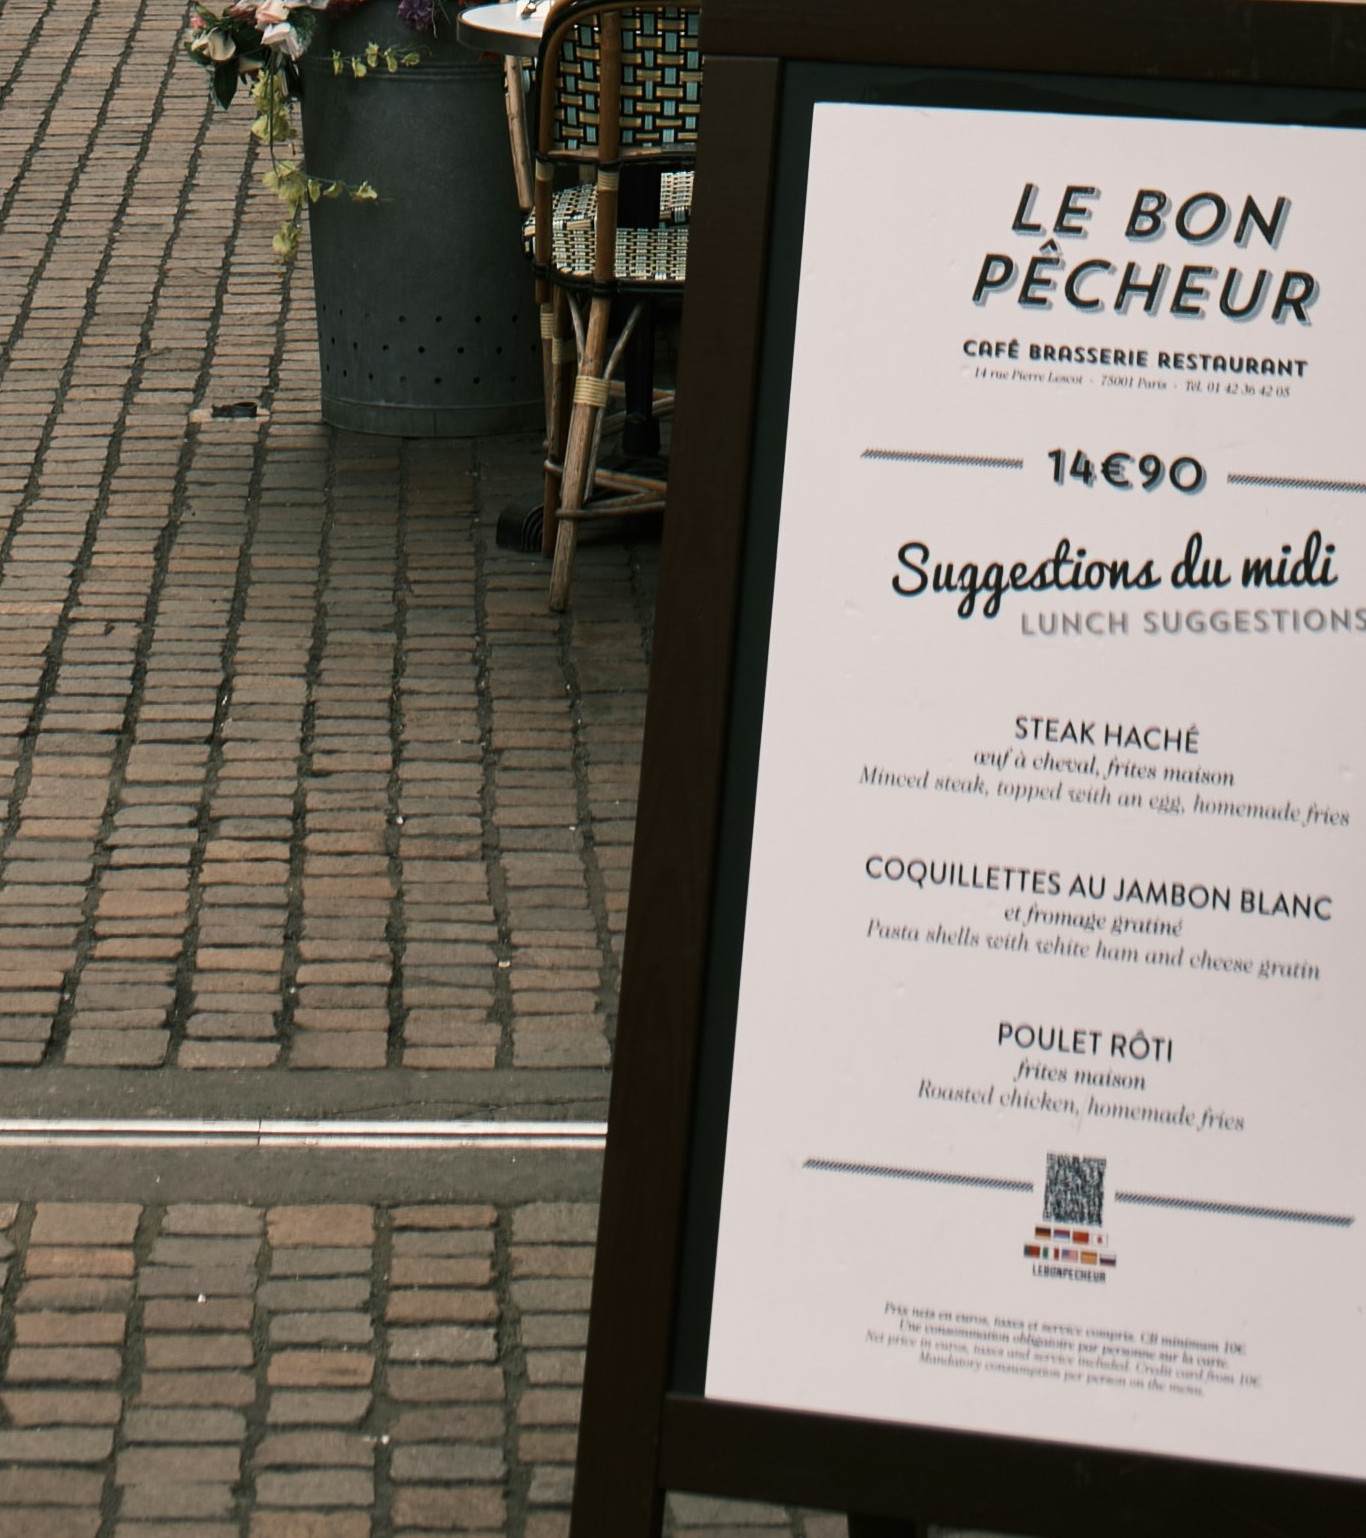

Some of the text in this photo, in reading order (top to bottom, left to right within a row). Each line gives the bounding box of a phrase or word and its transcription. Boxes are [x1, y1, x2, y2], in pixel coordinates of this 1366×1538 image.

[1011, 183, 1292, 251] LE BON
[971, 238, 1321, 327] PÊCHEUR
[962, 339, 1309, 379] CAFÉ BRASSERIE RESTAURANT
[990, 370, 1009, 381] rue
[1011, 368, 1045, 383] Pierre
[1137, 377, 1168, 391] Paris
[1048, 448, 1206, 496] 14€90
[892, 530, 1339, 618] Suggestions du midi
[1021, 611, 1129, 636] LUNCH
[1014, 716, 1200, 755] STEAK HACHÉ
[974, 747, 1236, 788] œuf à cheval, frites maison
[858, 764, 1351, 829] Minced steak, topped with an egg, homemade fries
[865, 855, 1333, 921] COQUILLETTES AU JAMBON BLANC
[1004, 901, 1185, 940] et fromage gratiné
[866, 918, 1320, 981] Pasta shells with white ham and cheese gratin
[997, 1022, 1174, 1063] POULET RÔTI
[1014, 1058, 1147, 1091] frites maison
[918, 1079, 1246, 1132] Roasted chicken, homemade fries
